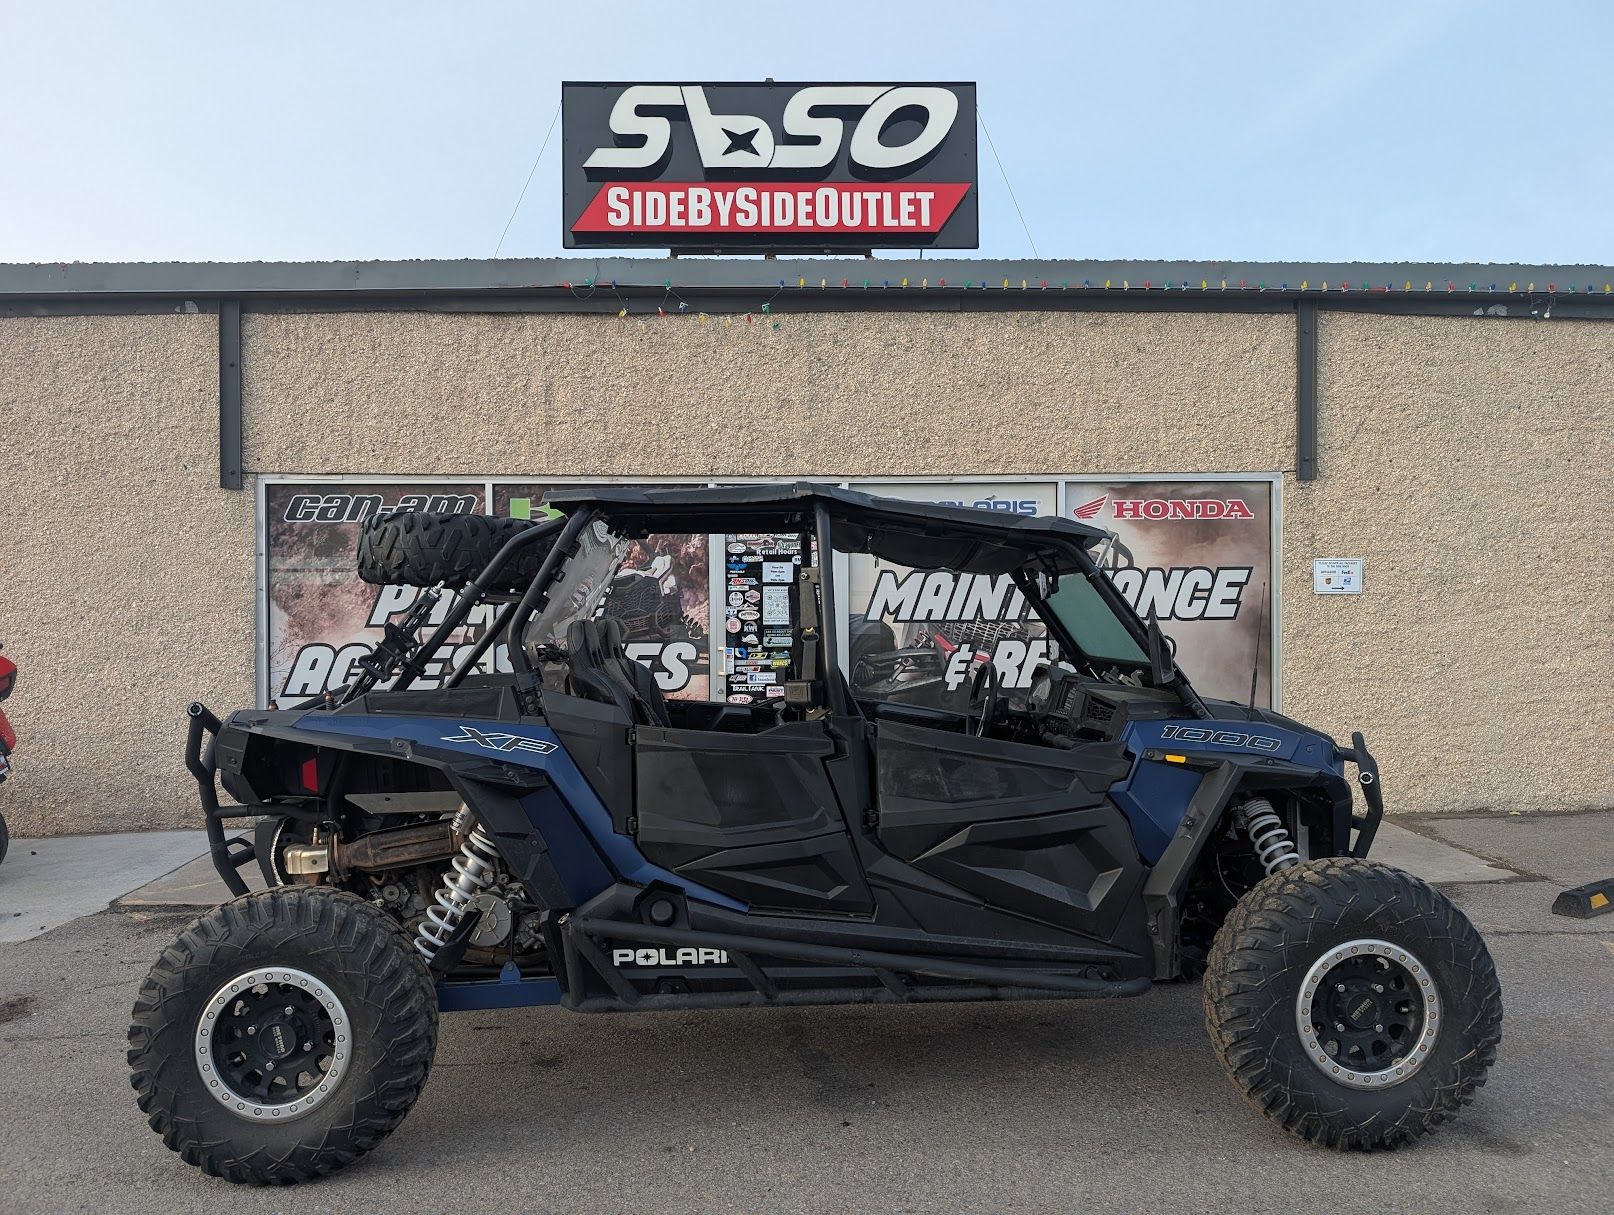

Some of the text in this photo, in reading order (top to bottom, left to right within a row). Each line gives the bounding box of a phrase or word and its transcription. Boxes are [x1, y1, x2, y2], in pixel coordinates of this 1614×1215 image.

[1112, 499, 1254, 519] HONDA
[440, 726, 559, 754] XP
[1160, 725, 1282, 751] 1000
[613, 947, 730, 966] POLARI
